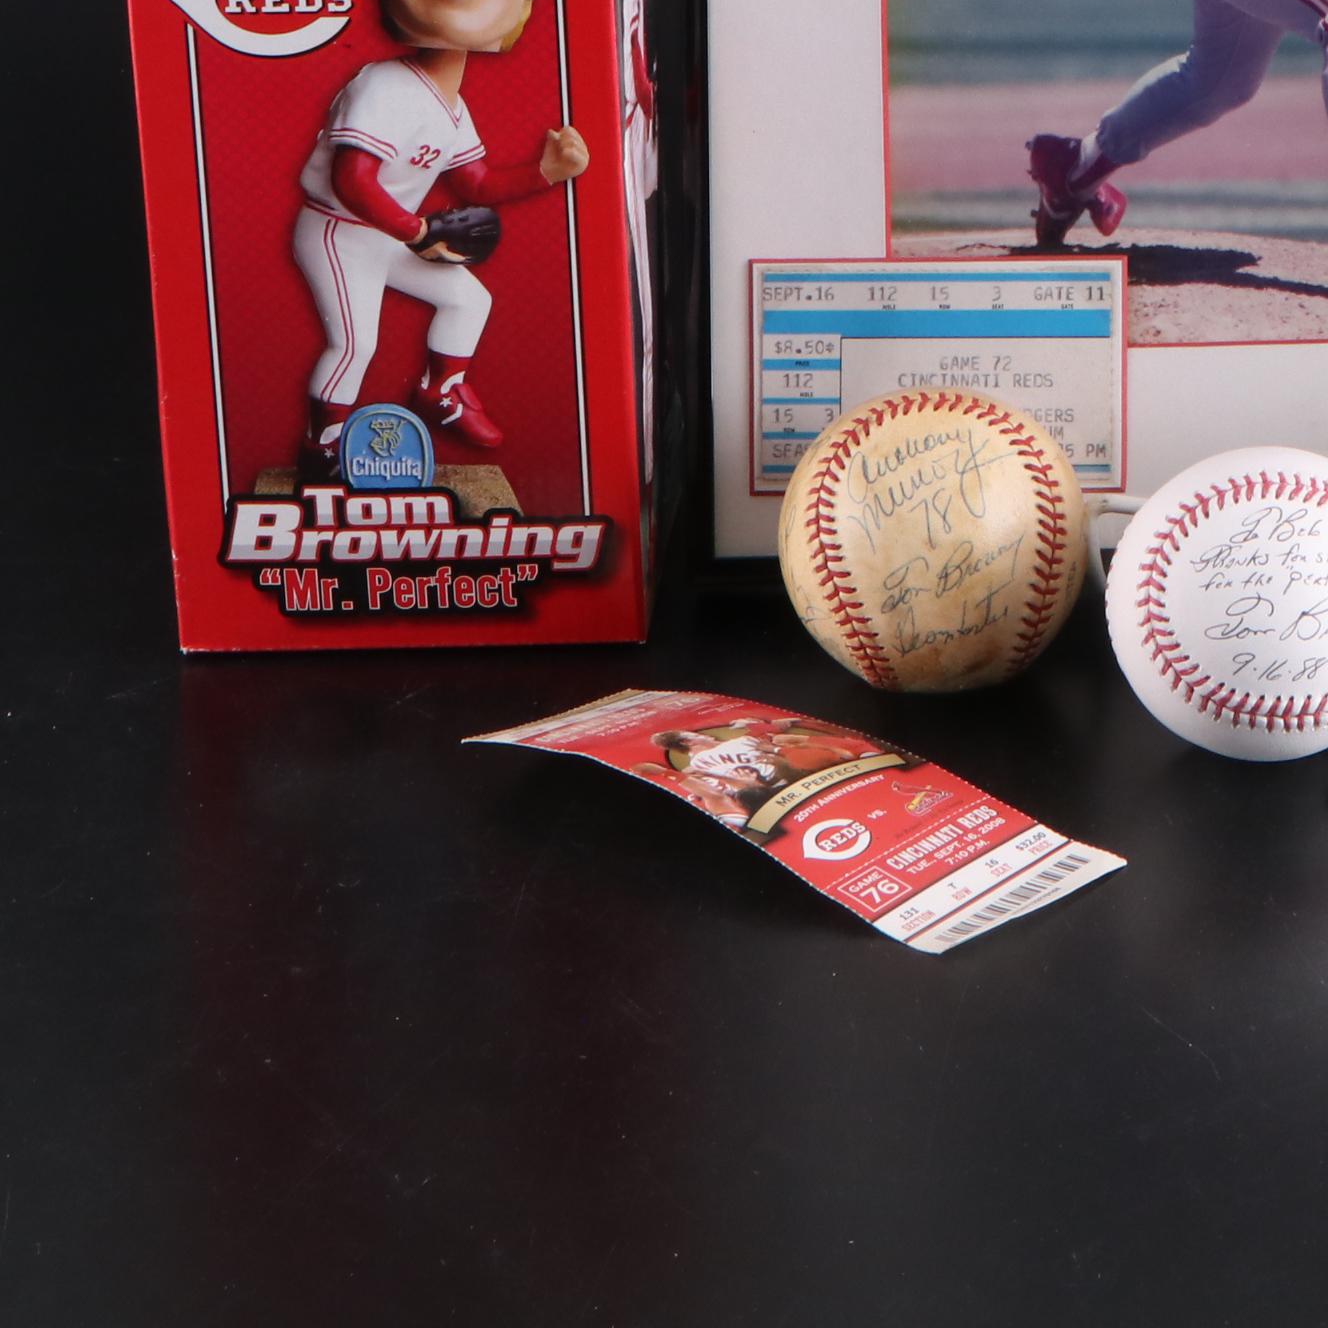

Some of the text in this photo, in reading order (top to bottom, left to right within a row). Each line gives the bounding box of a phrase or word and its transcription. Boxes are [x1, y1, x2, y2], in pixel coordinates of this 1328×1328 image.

[410, 145, 441, 169] 32
[762, 286, 1105, 302] SEPT.16 112 15 3 GATE 11
[940, 355, 1012, 371] GAME 72
[783, 373, 813, 388] 112
[898, 373, 1054, 388] CINCINNATI REDS
[773, 408, 834, 423] 15 3
[1086, 443, 1107, 458] PM
[351, 455, 422, 481] Chiquita
[303, 487, 452, 528] Tom
[908, 488, 952, 550] 78
[226, 515, 605, 571] Browning
[1276, 543, 1307, 567] for
[1200, 572, 1232, 591] for
[1241, 572, 1272, 589] the
[776, 764, 860, 807] MR. PERFECT
[794, 803, 820, 822] 20TH
[817, 774, 885, 808] ANNIVERSARY
[819, 822, 866, 851] REDS
[886, 805, 998, 870] CINCINNATI REDS
[934, 840, 965, 860] SEPT.
[979, 817, 1006, 835] 2008
[945, 839, 990, 865] 7:10 P.M.
[848, 871, 883, 893] GAME
[859, 878, 899, 904] 76
[900, 907, 919, 921] 131
[948, 881, 956, 889] T
[985, 858, 999, 869] 16
